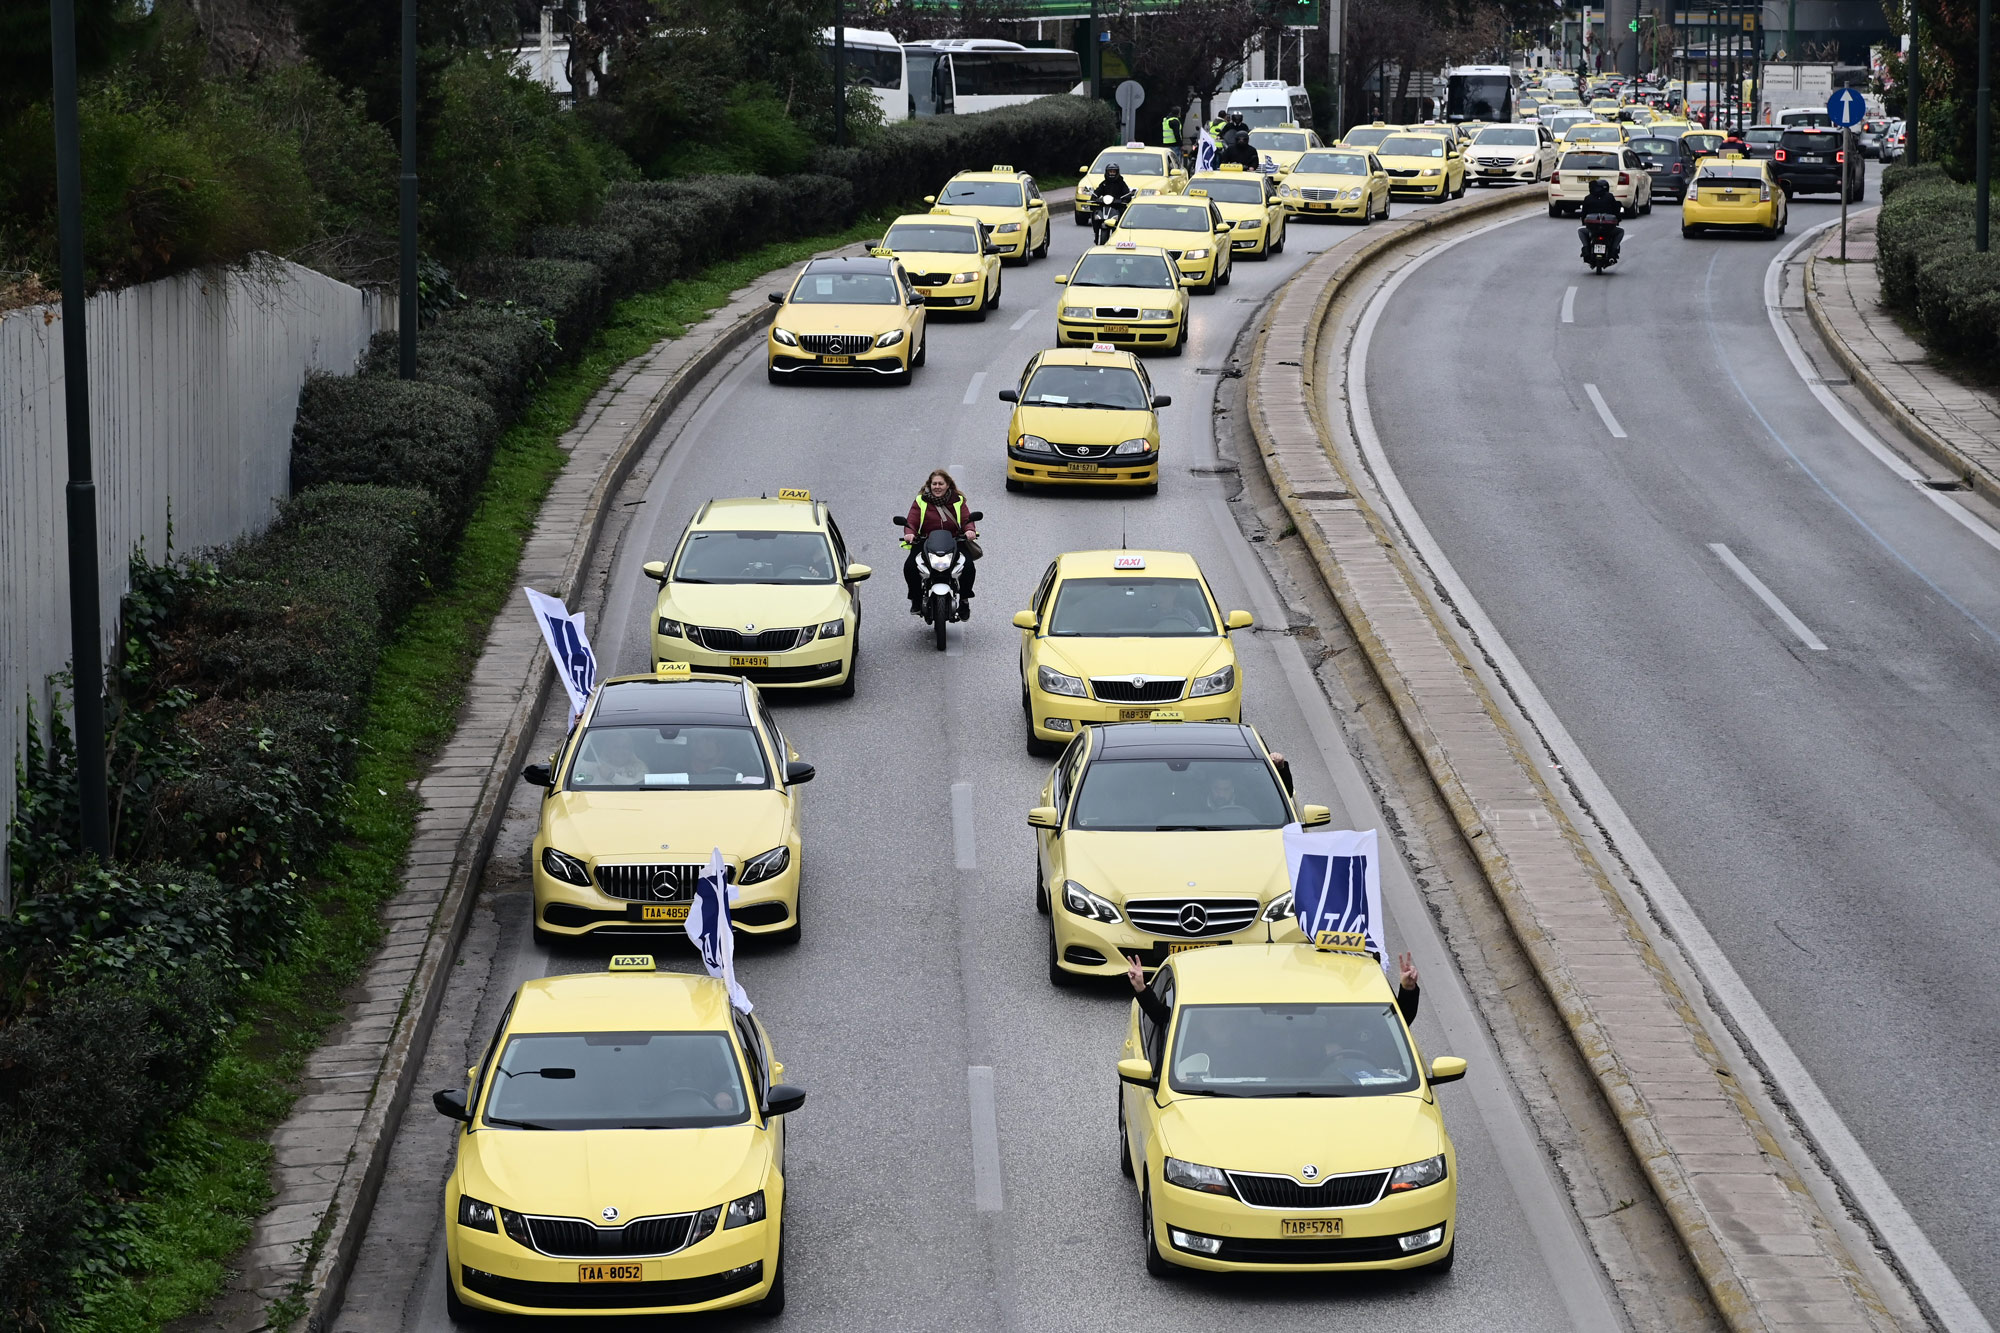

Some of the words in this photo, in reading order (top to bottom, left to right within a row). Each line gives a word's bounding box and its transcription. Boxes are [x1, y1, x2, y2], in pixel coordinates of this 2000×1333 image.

[781, 489, 808, 498] TAXI
[732, 657, 767, 665] TAA-4914
[644, 907, 690, 919] TAA-4858
[1320, 933, 1363, 947] TAXI
[616, 957, 649, 965] TAXI
[1284, 1221, 1341, 1236] TAB-5784
[581, 1266, 640, 1280] TAA-8052
